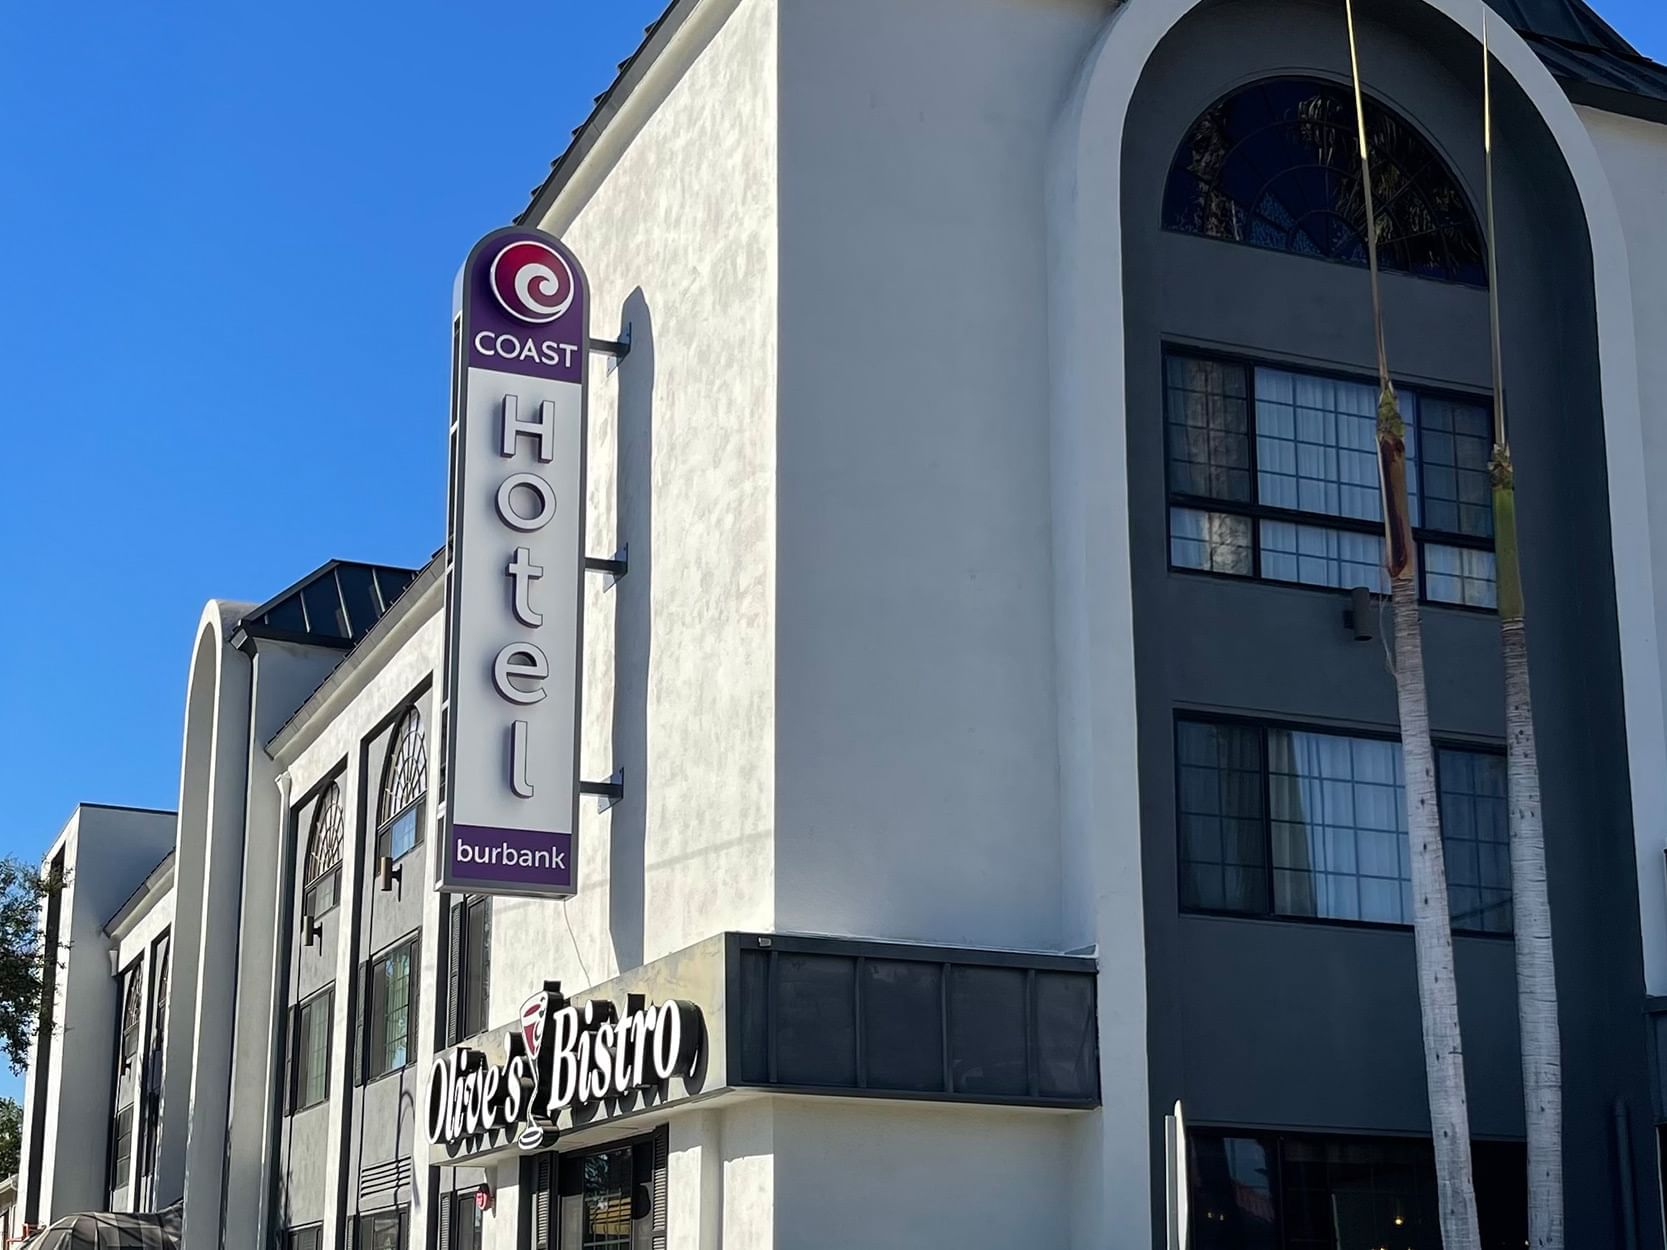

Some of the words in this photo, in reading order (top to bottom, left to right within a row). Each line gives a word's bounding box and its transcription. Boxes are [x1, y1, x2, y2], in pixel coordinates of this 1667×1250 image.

[474, 331, 578, 368] COAST
[456, 838, 566, 870] burbank
[424, 1031, 523, 1145] Olive's
[546, 999, 681, 1112] Bistro
